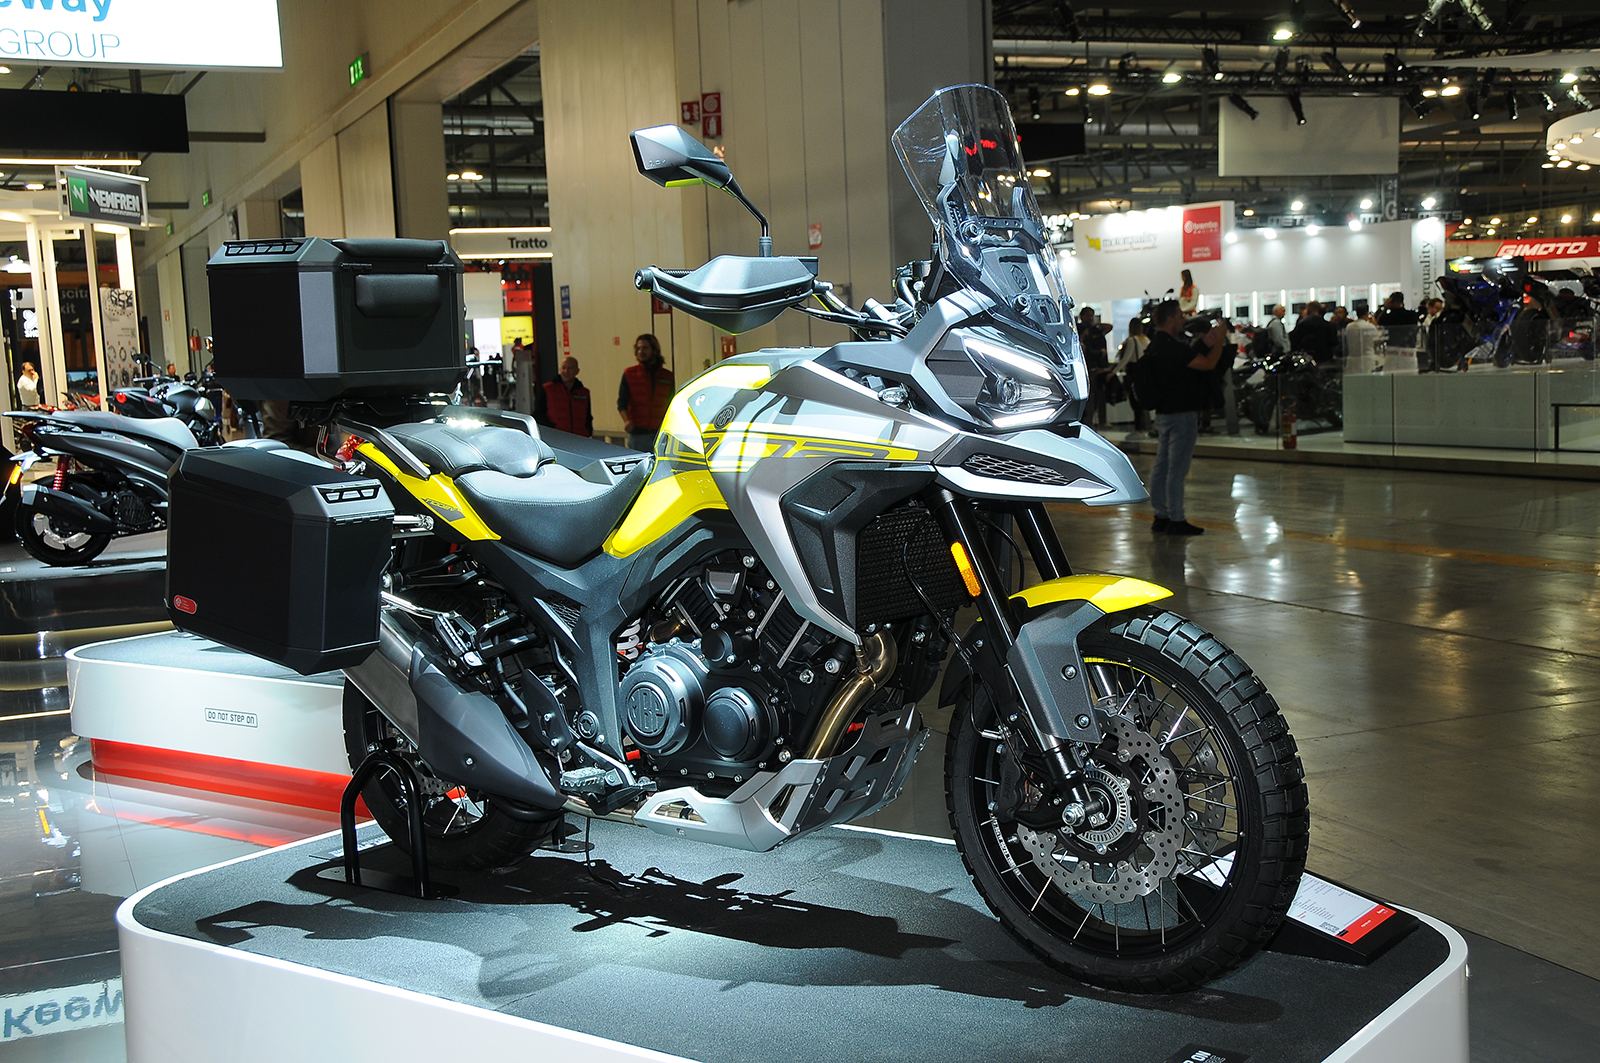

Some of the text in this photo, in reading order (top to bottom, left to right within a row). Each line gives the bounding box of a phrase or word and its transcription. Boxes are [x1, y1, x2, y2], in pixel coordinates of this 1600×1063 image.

[0, 28, 120, 58] GROUP
[87, 186, 141, 212] NEWFREN
[508, 238, 548, 249] Tratto
[1497, 242, 1588, 257] GIMOTO
